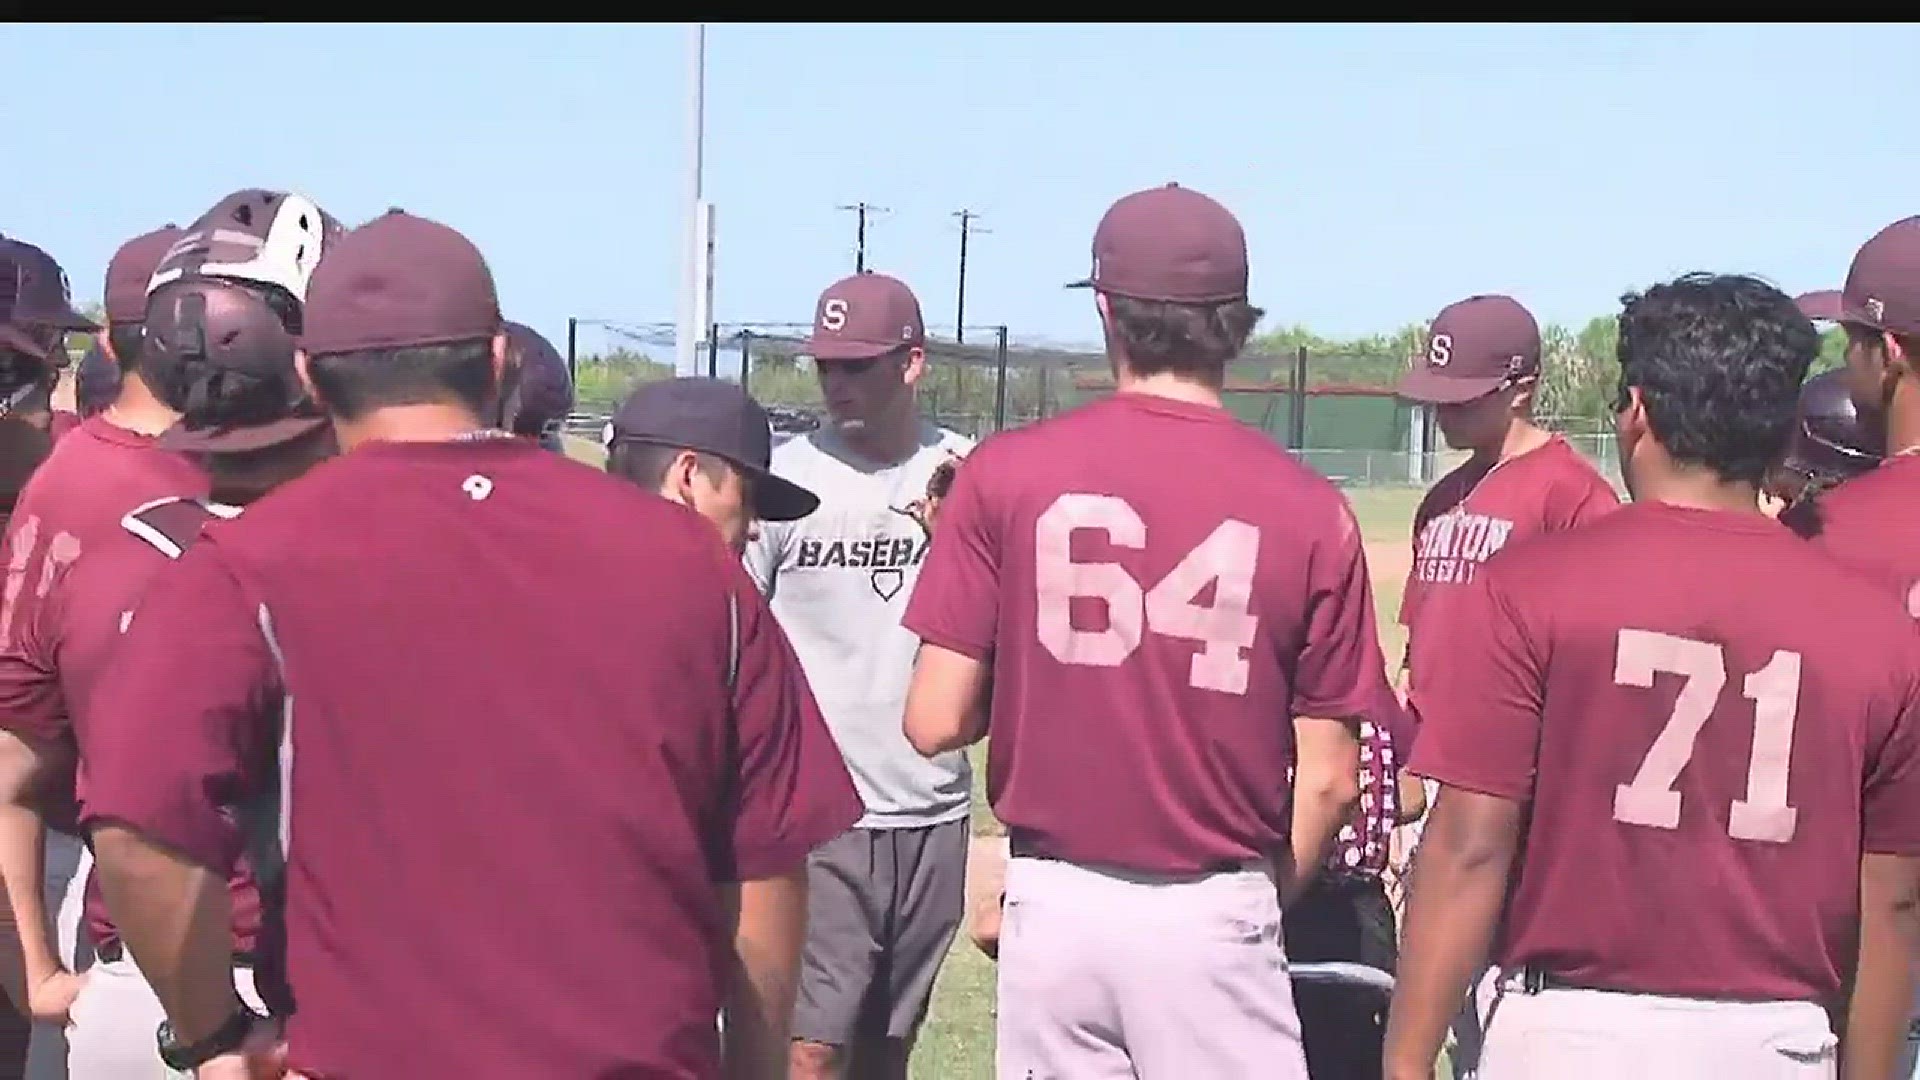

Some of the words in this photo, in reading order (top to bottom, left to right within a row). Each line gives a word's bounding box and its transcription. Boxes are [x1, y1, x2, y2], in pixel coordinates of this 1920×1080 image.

[822, 298, 848, 331] S
[1429, 333, 1452, 367] S
[1035, 492, 1260, 696] 64
[1612, 628, 1802, 843] 71
